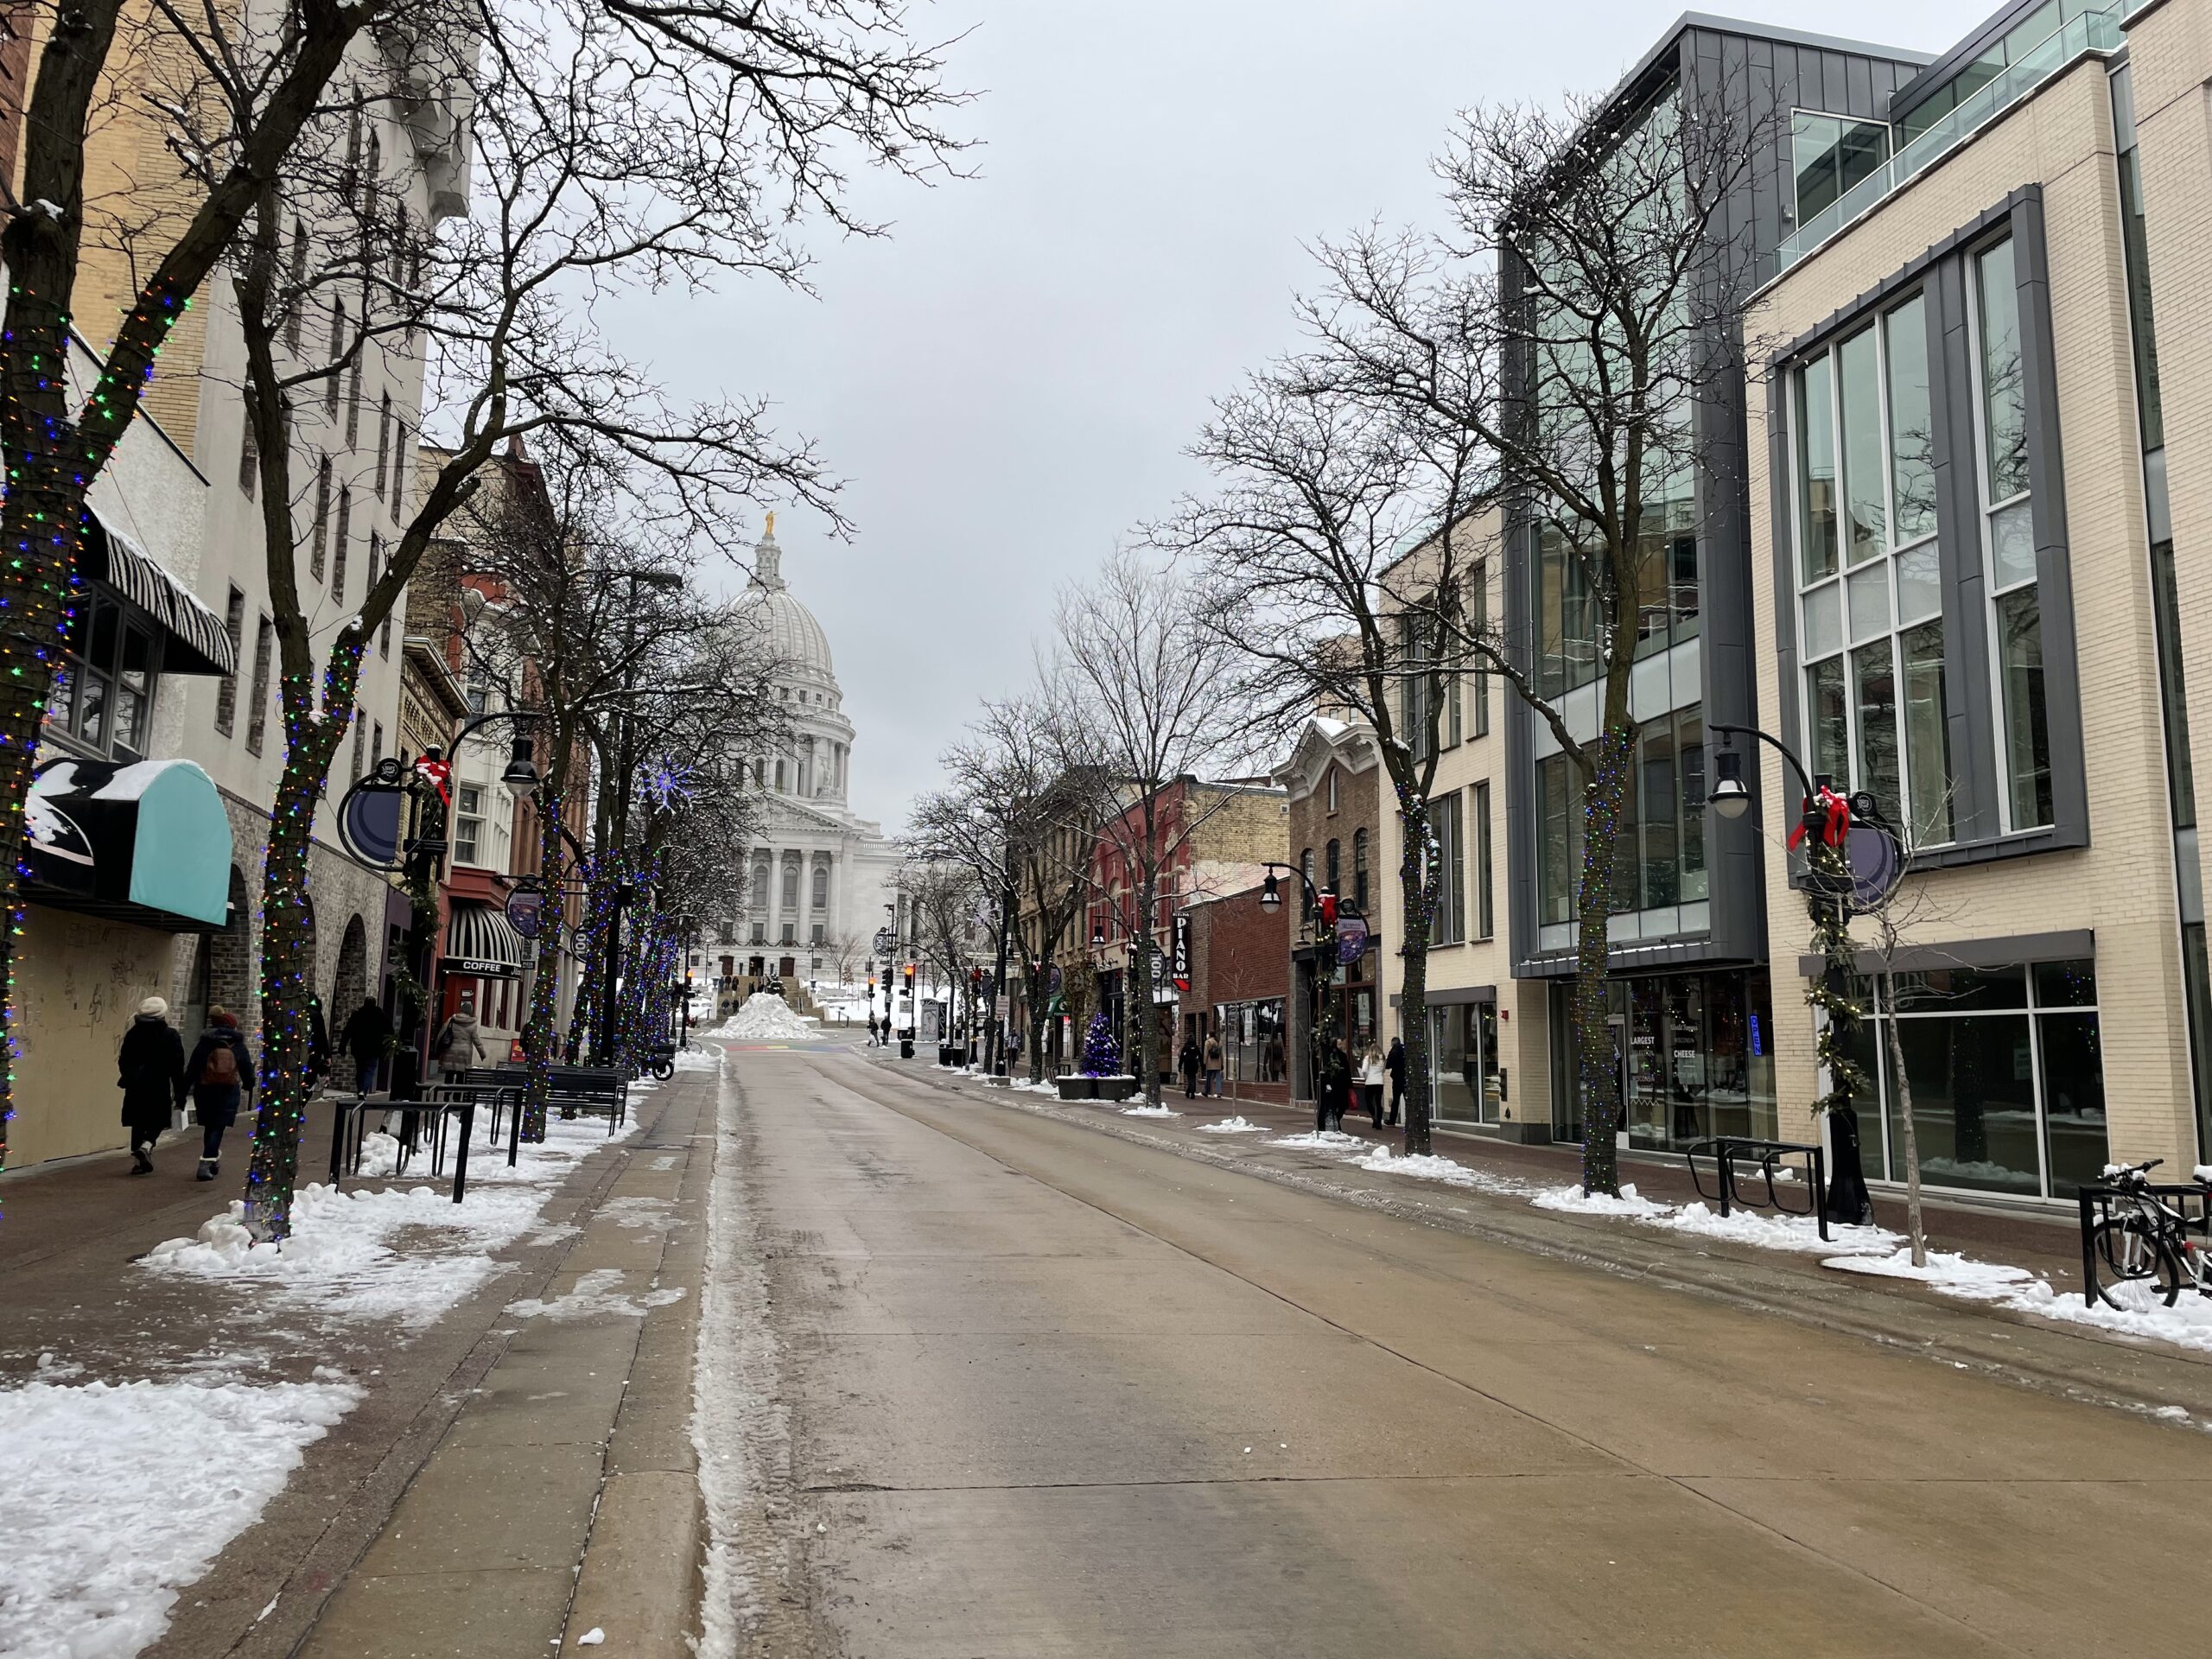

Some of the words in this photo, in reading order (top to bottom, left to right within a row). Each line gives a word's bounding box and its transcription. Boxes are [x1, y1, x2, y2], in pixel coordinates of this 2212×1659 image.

[575, 933, 586, 955] 100
[1176, 918, 1186, 971] PIANO
[463, 961, 501, 973] COFFEE
[1151, 957, 1162, 979] 100
